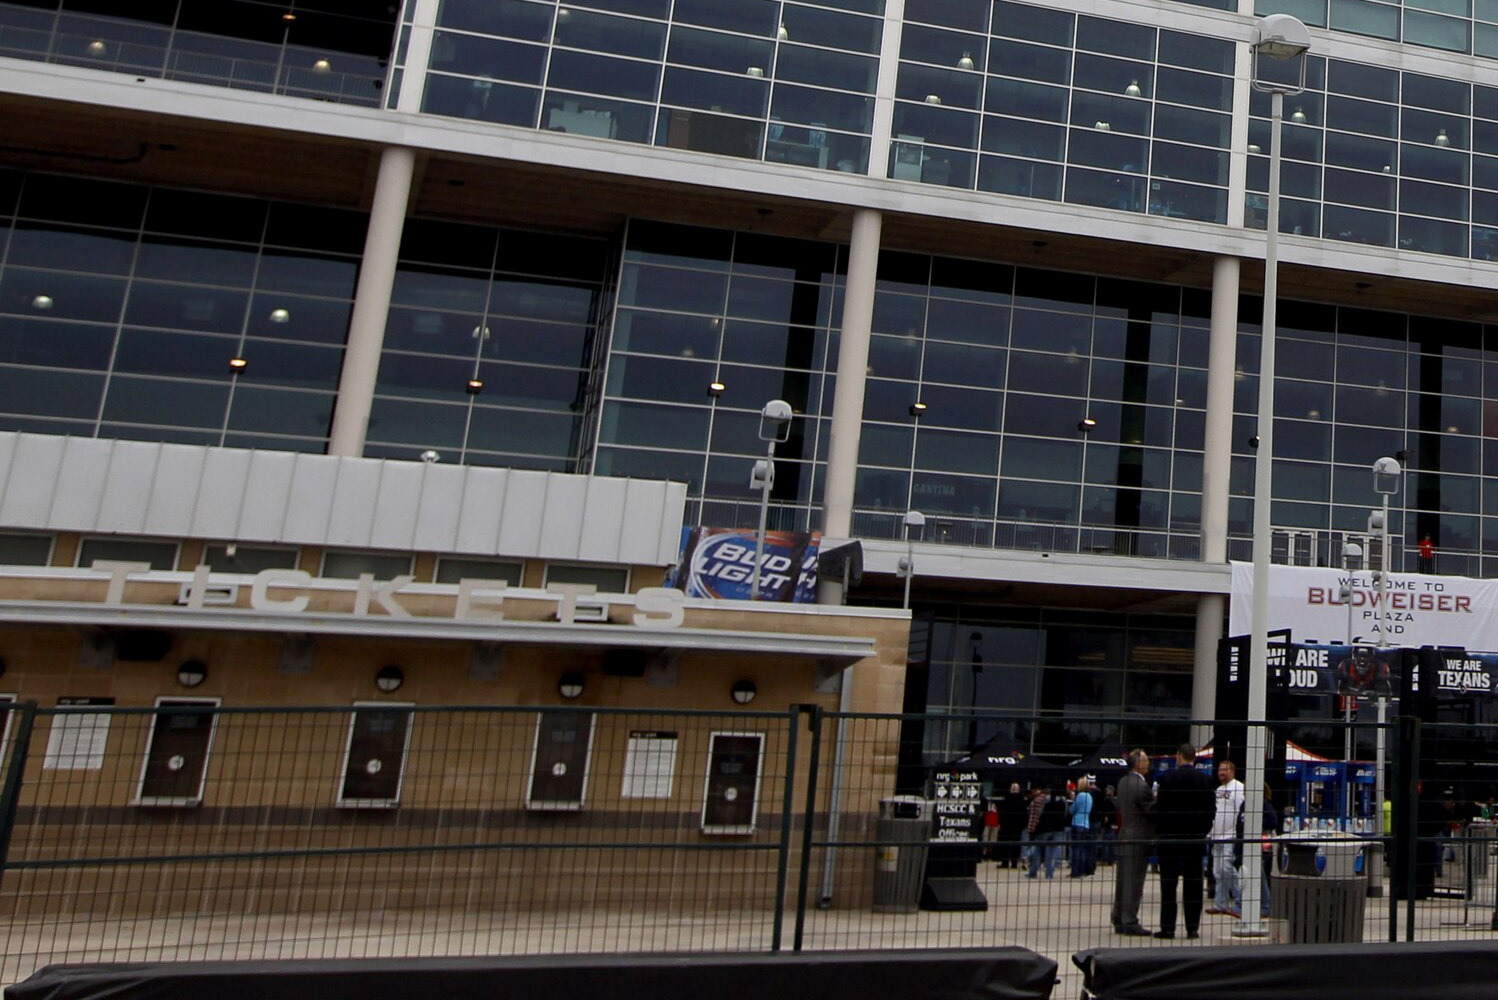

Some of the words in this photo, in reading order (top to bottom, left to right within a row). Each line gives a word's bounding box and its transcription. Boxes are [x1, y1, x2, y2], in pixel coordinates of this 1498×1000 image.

[713, 543, 792, 571] BUD
[1424, 582, 1444, 592] TO
[92, 559, 685, 629] TICKETS
[1363, 611, 1414, 622] PLAZA
[1371, 624, 1405, 634] AND
[1295, 649, 1329, 667] ARE
[1446, 659, 1463, 670] WE
[1463, 660, 1482, 671] ARE
[1437, 671, 1490, 688] TEXANS
[988, 756, 1016, 765] nrg
[1100, 757, 1128, 766] nrg
